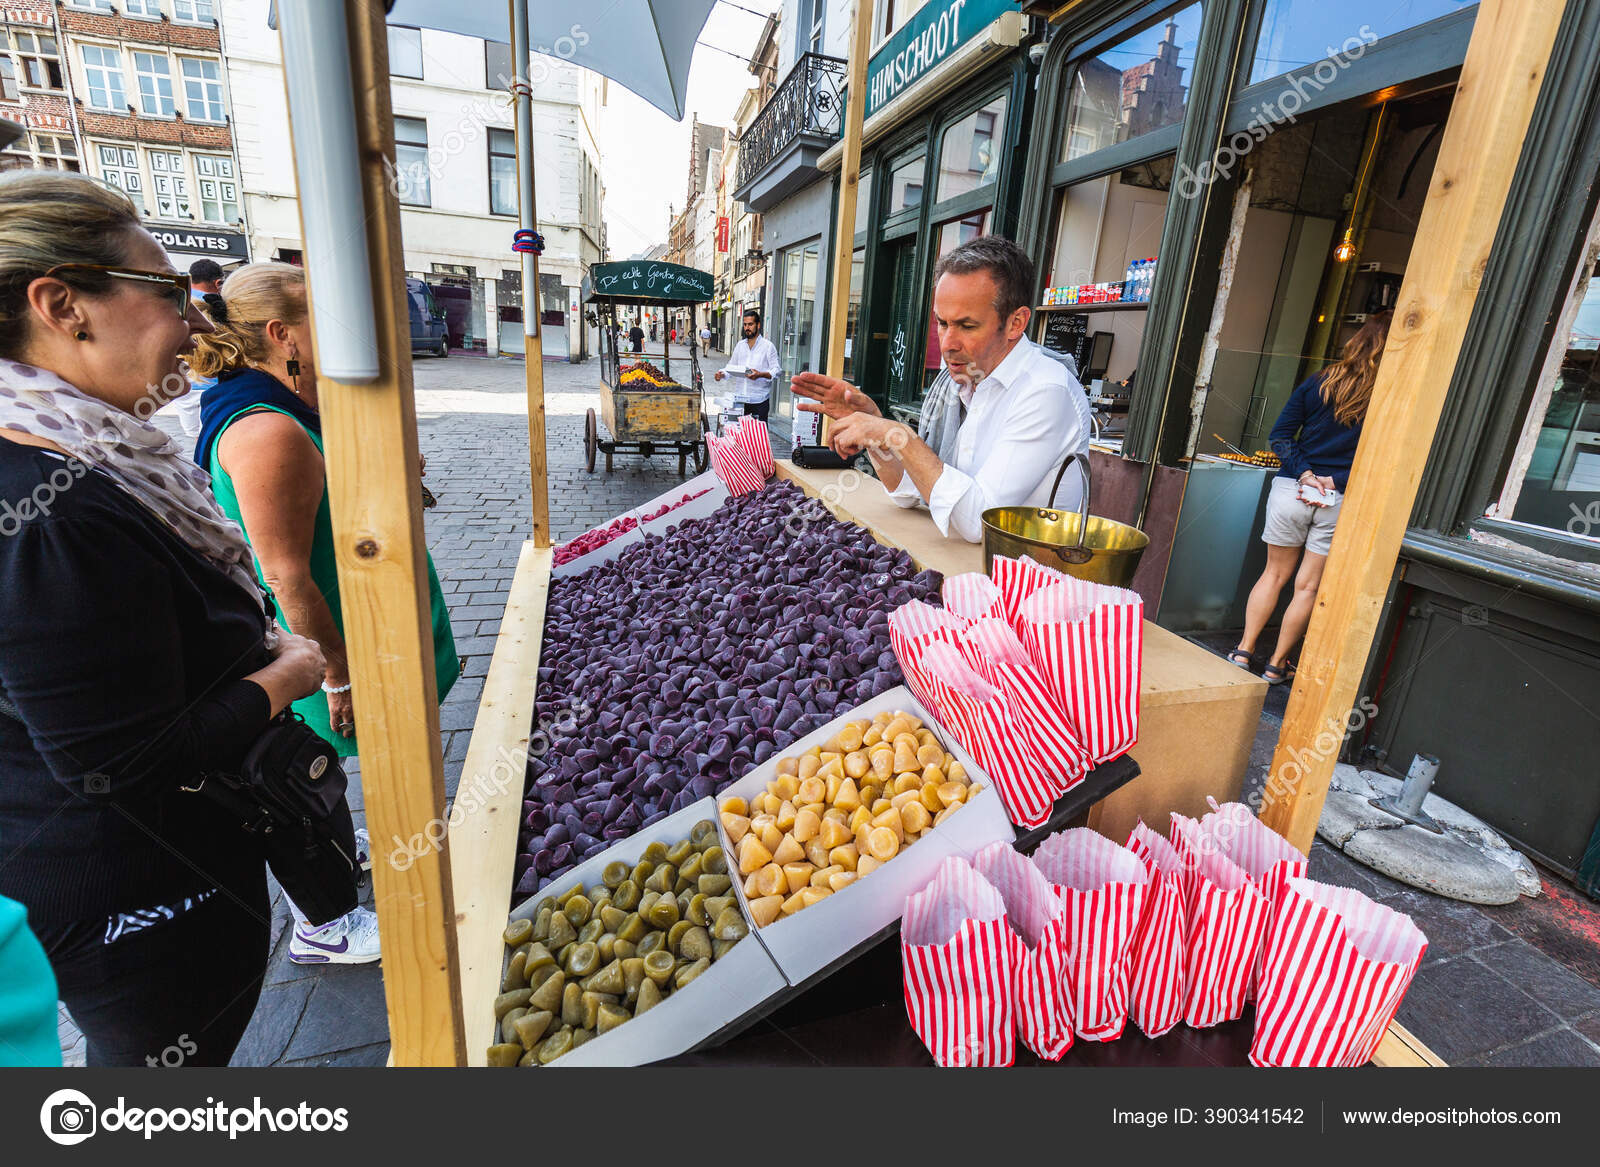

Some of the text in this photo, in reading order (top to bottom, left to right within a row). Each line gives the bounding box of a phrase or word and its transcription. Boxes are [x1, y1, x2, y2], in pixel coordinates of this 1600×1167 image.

[870, 1, 965, 112] HIMSCHOOT
[103, 146, 230, 175] WAFFLE
[110, 173, 234, 199] COFFEE
[600, 275, 618, 289] De
[647, 264, 675, 289] Gentse
